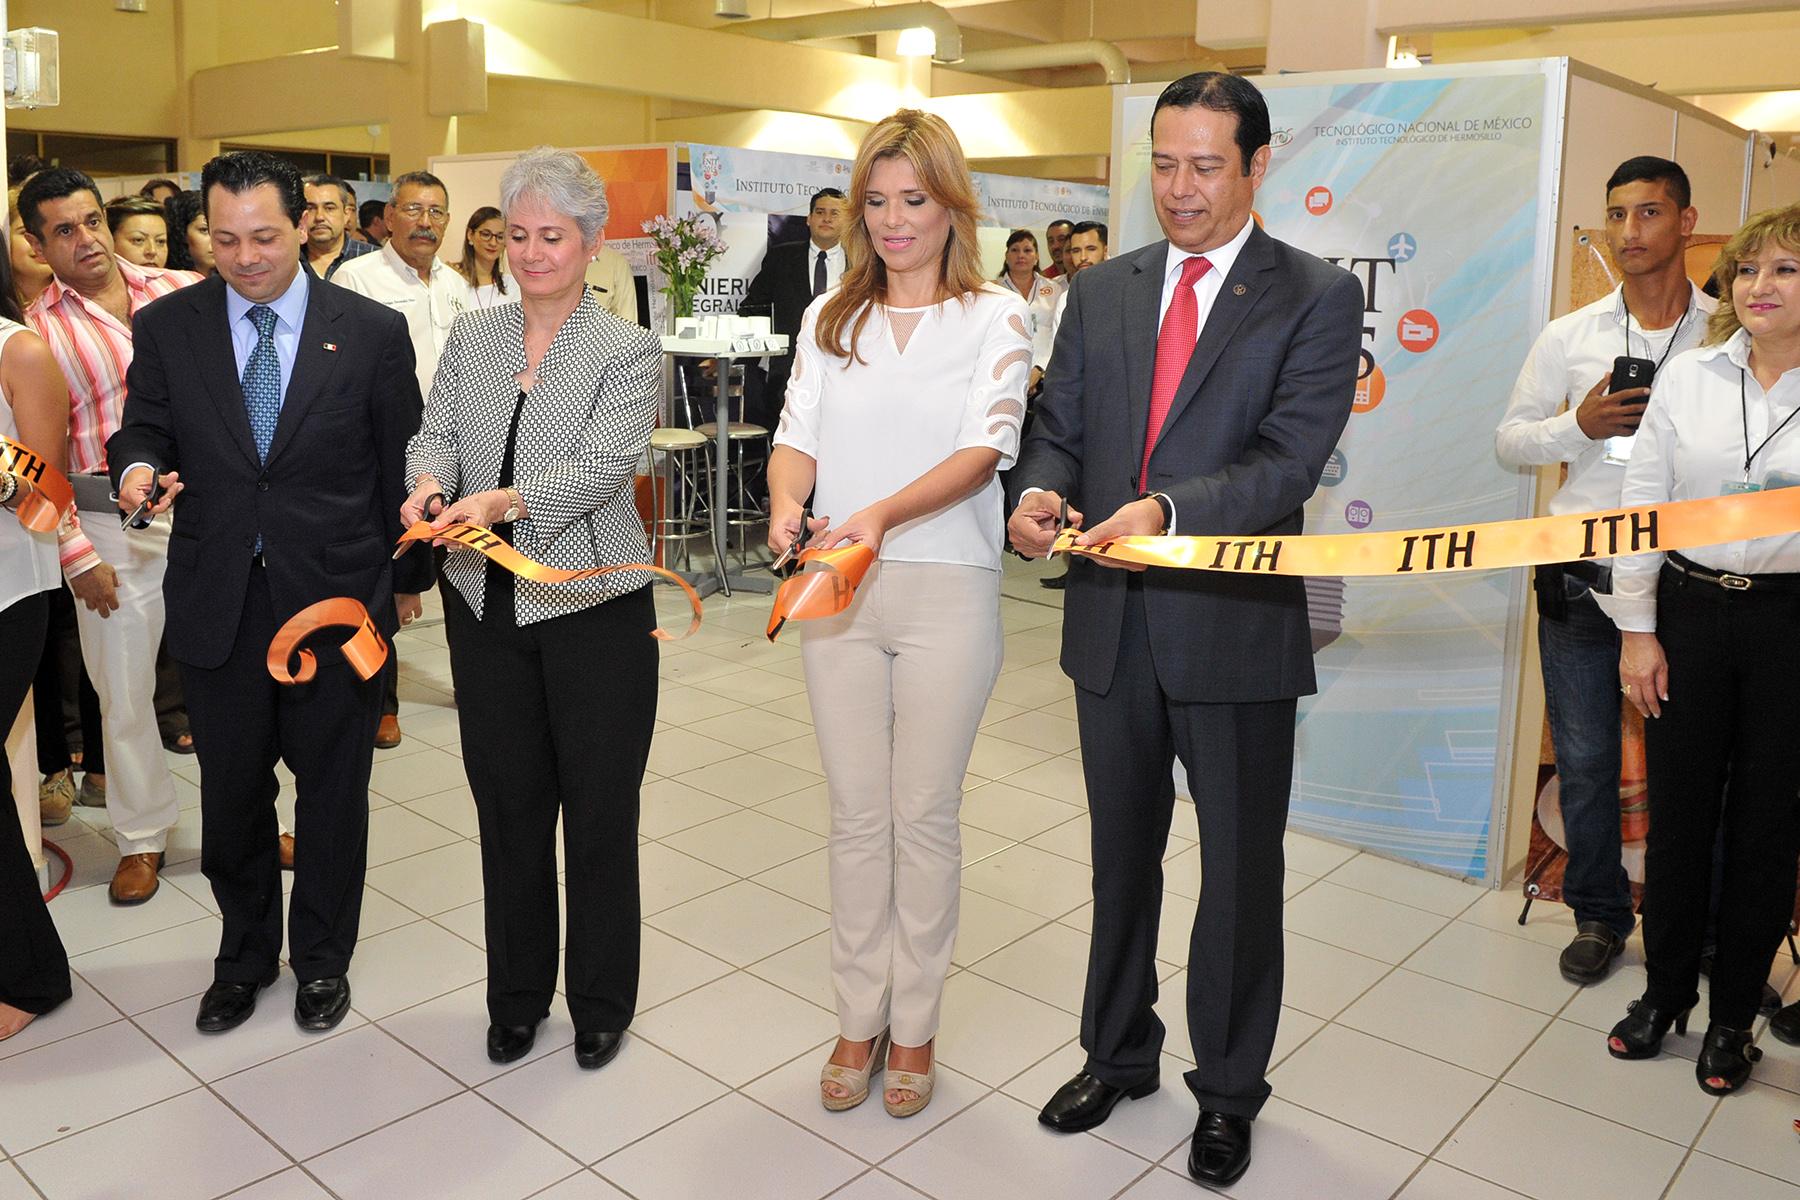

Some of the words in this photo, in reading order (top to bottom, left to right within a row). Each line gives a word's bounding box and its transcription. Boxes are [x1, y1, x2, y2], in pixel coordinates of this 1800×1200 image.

[1314, 123, 1395, 137] TECNOLÓGICO
[1398, 120, 1460, 133] NACIONAL
[1464, 119, 1480, 131] DE
[1483, 116, 1532, 130] MÉXICO
[1336, 137, 1377, 146] INSTITUTO
[1379, 134, 1437, 145] TECNOLÓGICO
[1439, 134, 1449, 142] DE
[1450, 132, 1502, 141] HERMOSILLO
[736, 179, 794, 194] INSTITUTO
[987, 195, 1028, 209] INSTITUTO
[1031, 199, 1080, 214] TECNOLÓGICO
[1579, 510, 1659, 558] ITH
[1208, 540, 1283, 571] ITH
[1397, 530, 1476, 572] ITH
